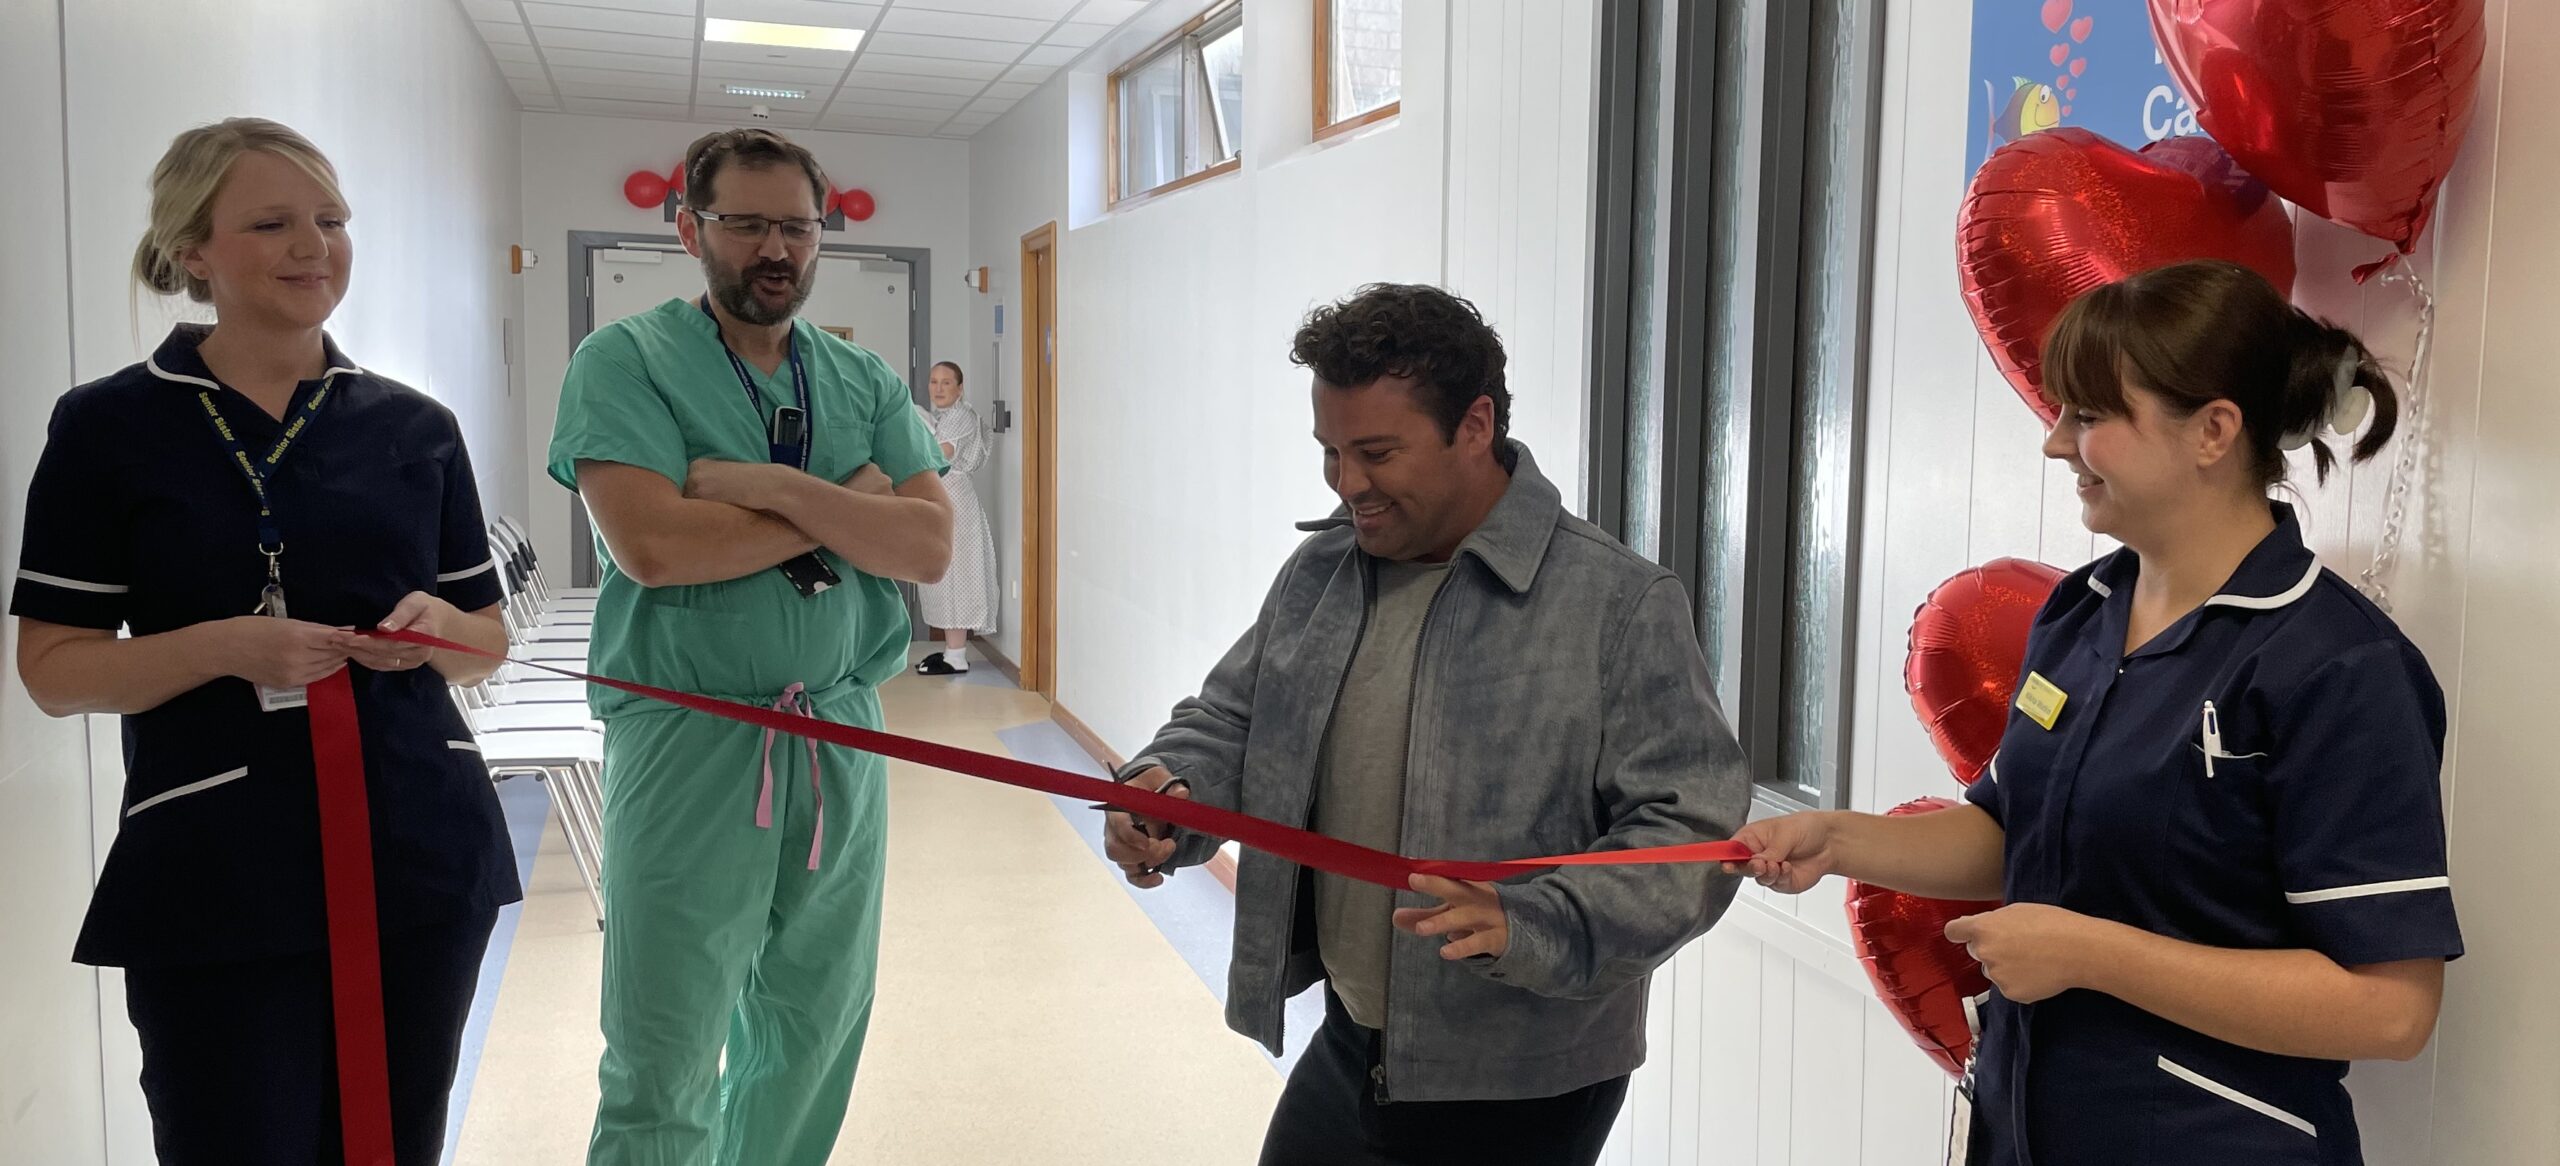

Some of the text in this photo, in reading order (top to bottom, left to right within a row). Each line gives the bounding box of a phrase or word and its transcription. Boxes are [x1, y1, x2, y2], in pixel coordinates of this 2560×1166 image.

[2142, 85, 2205, 141] Ca
[198, 392, 235, 441] Senior Sister
[266, 416, 306, 464] Senior Sister
[235, 451, 256, 477] Senior
